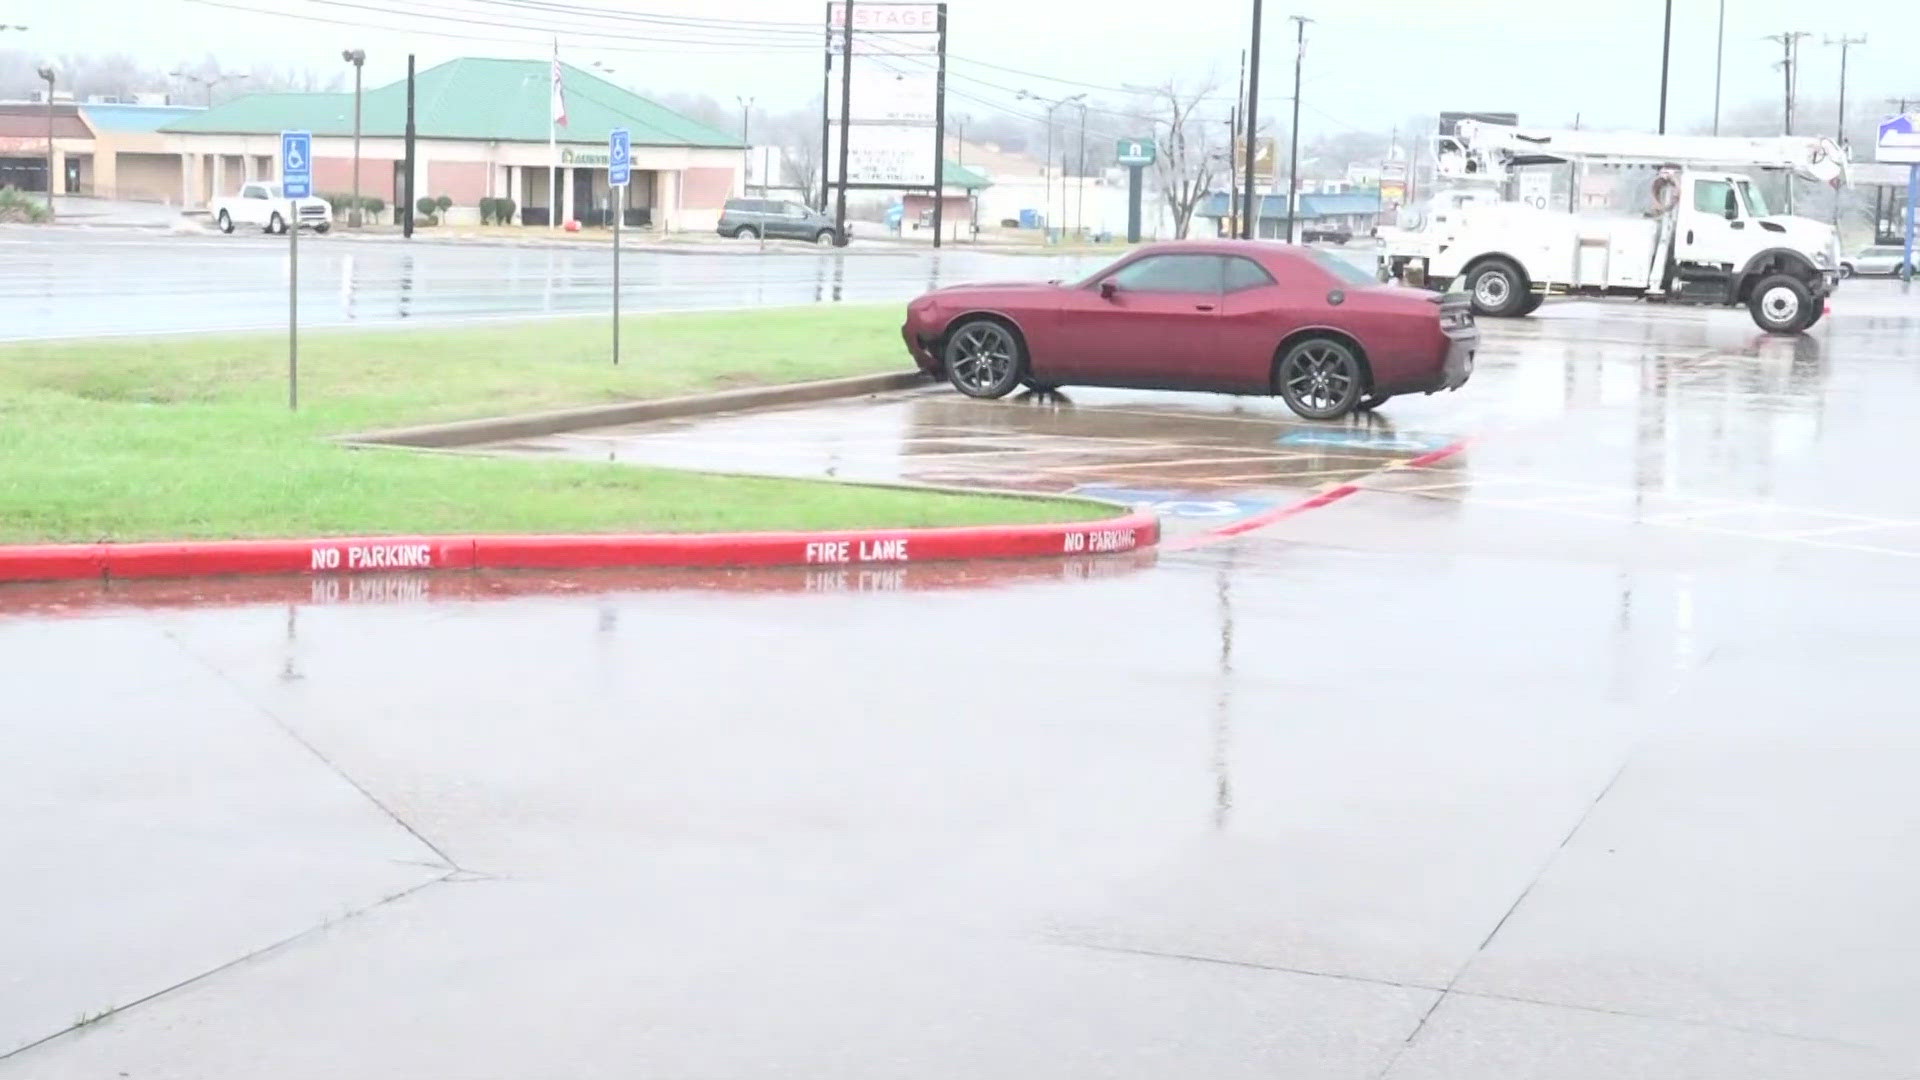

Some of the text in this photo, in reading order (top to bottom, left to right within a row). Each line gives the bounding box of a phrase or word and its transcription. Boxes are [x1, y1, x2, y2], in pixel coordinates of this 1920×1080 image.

[855, 9, 933, 26] STAGE
[806, 538, 908, 563] FIRE LANE
[1064, 528, 1136, 551] NO PARKING
[311, 544, 430, 569] NO PARKING
